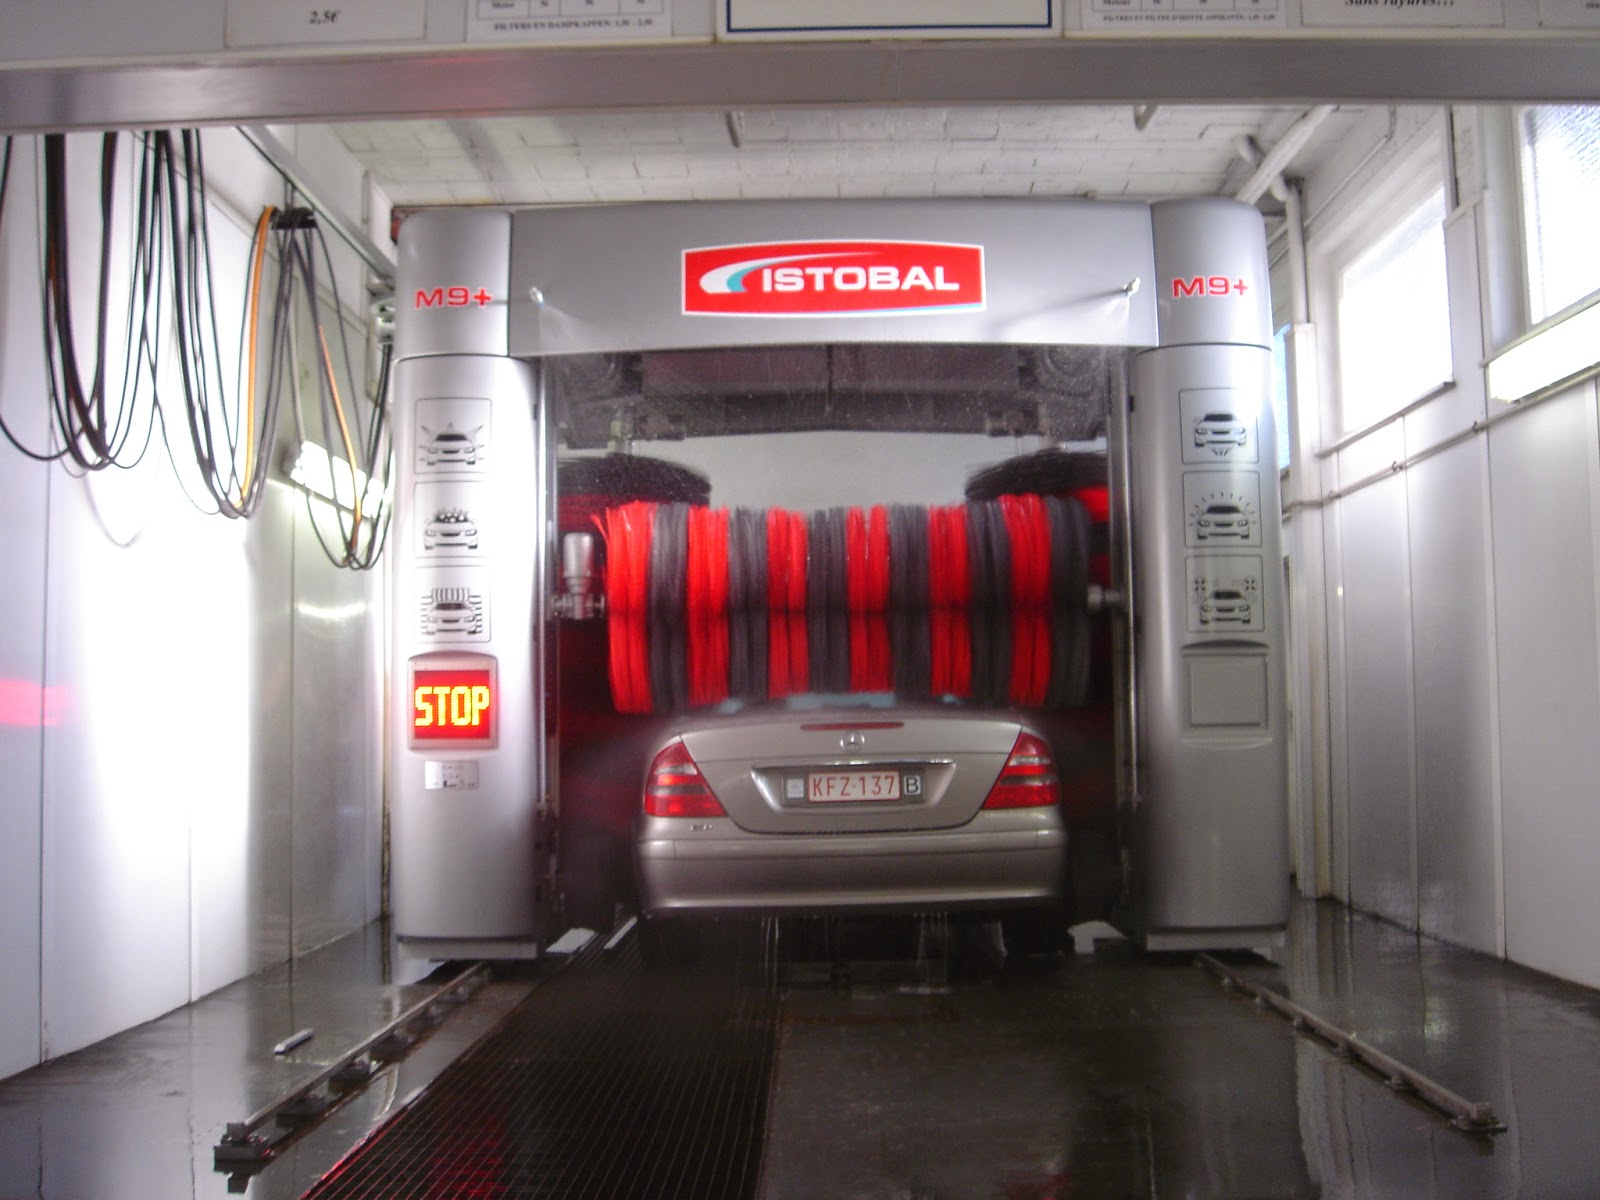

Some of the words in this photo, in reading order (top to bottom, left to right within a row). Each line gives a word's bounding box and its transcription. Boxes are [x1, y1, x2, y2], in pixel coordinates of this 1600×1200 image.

[761, 265, 961, 293] ISTOBAL
[1172, 276, 1248, 299] M9+
[415, 286, 492, 309] M9+
[414, 685, 490, 727] STOP
[905, 776, 919, 794] B
